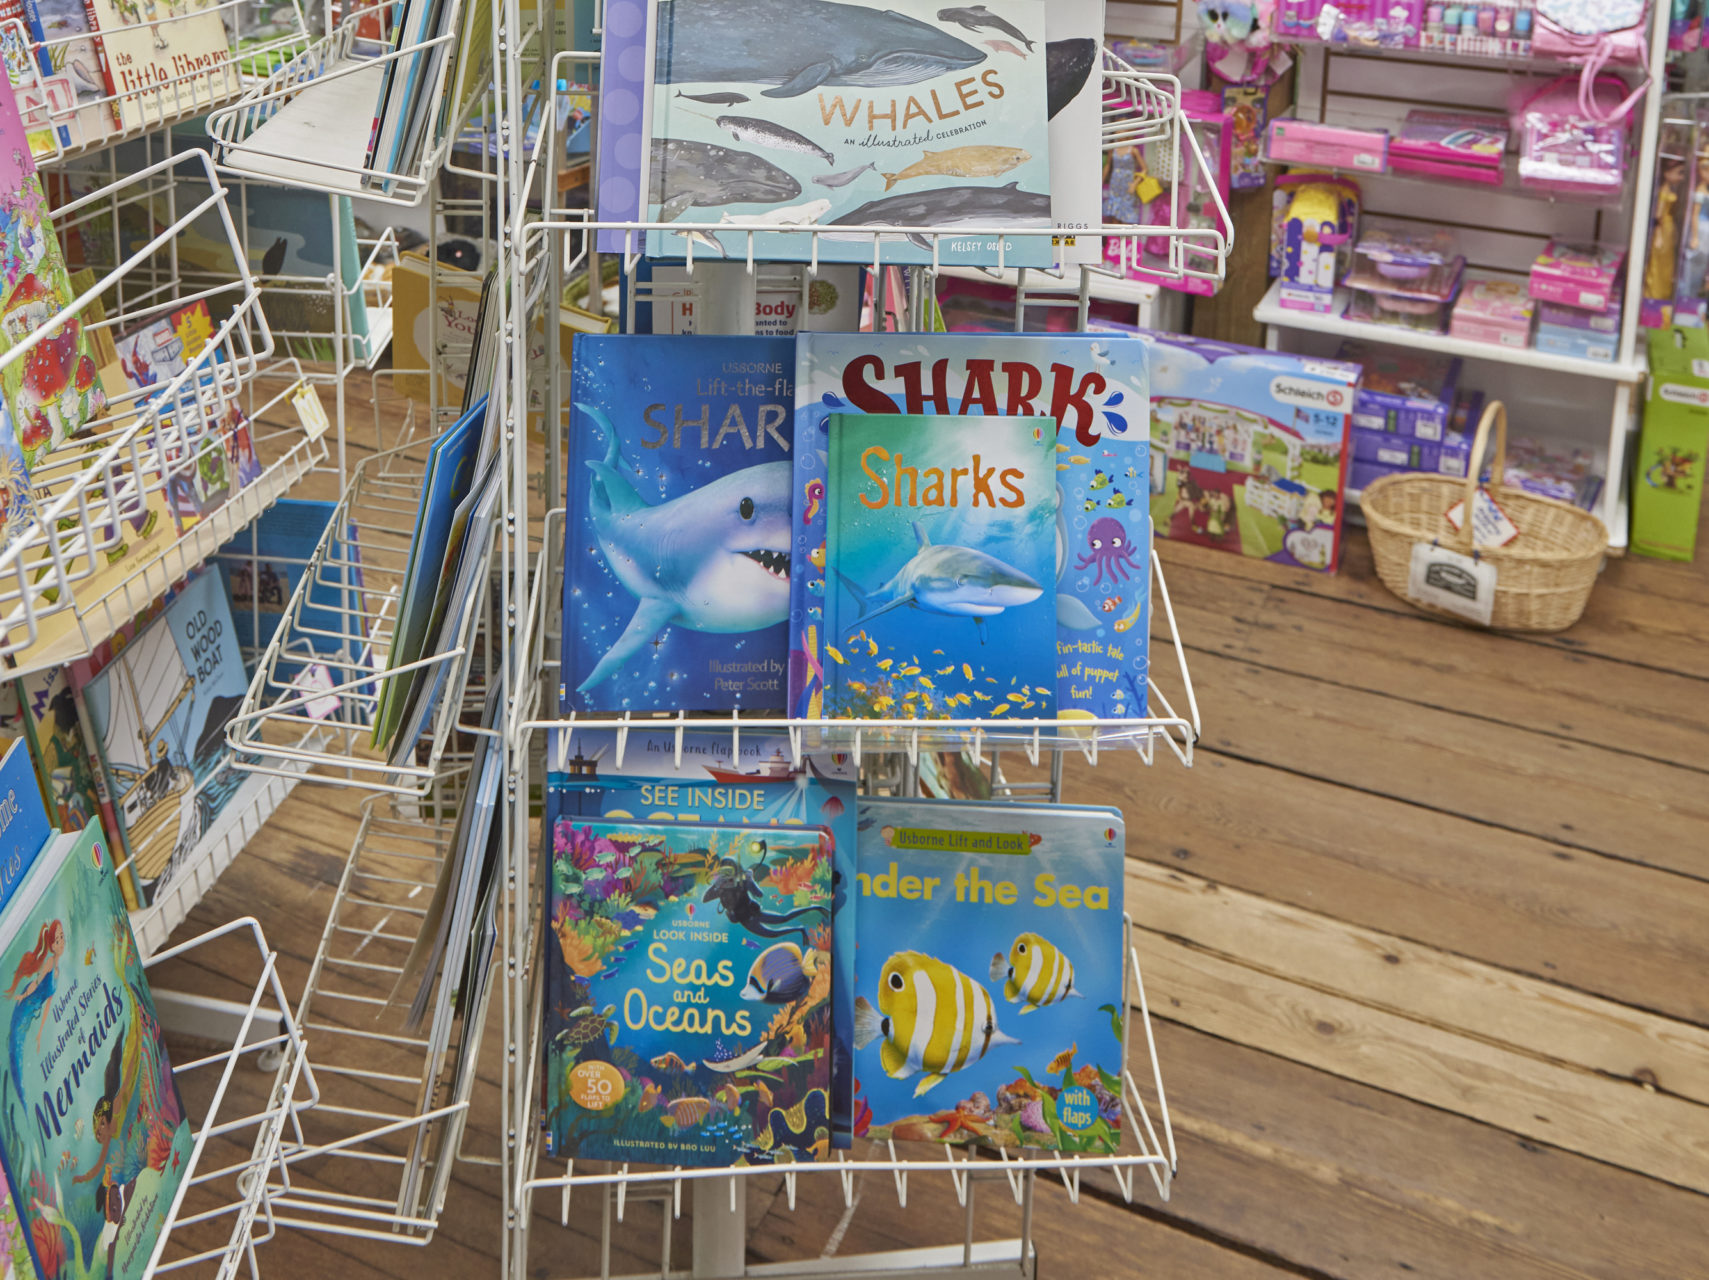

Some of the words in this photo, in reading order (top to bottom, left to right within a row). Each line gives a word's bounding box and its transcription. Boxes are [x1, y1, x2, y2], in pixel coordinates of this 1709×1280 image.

[116, 52, 132, 66] the
[120, 63, 169, 102] little
[172, 49, 229, 86] library
[818, 68, 1004, 131] WHALES
[858, 129, 934, 148] illustrated
[936, 119, 987, 140] CELEBRATION
[951, 241, 982, 252] KELSEY
[722, 362, 783, 374] USBORNE
[842, 355, 1106, 447] SHARK
[641, 403, 790, 452] SHAR
[858, 446, 1025, 509] Sharks
[186, 610, 207, 640] OLD
[191, 620, 222, 663] WOOD
[1107, 643, 1124, 661] tale
[197, 644, 223, 684] BOAT
[709, 659, 768, 673] Illustrated
[770, 659, 784, 677] by
[1071, 661, 1082, 676] of
[1084, 666, 1119, 684] puppet
[714, 677, 744, 691] Peter
[747, 677, 779, 691] Scott
[1071, 684, 1092, 700] fun!
[647, 739, 660, 752] An
[664, 741, 708, 755] Usorne
[641, 786, 679, 807] SEE
[688, 788, 765, 810] INSIDE
[899, 831, 945, 847] Usborne
[949, 833, 968, 848] Lift
[972, 835, 992, 850] and
[996, 836, 1023, 851] Look
[954, 866, 1018, 905] the
[1033, 873, 1109, 910] Sea
[672, 920, 710, 929] USBORNE
[653, 929, 686, 941] LOOK
[690, 931, 728, 943] INSIDE
[646, 942, 735, 987] Seas
[52, 978, 79, 1023] Usborne
[673, 986, 710, 1004] and
[623, 988, 751, 1037] Oceans
[40, 1008, 80, 1083] Illustrated
[78, 974, 101, 1017] Stories
[77, 1027, 86, 1045] of
[35, 981, 124, 1159] Mermaids
[577, 1070, 601, 1079] OVER
[587, 1079, 612, 1095] 50
[580, 1094, 601, 1102] FLAPS
[1064, 1089, 1090, 1106] with
[1063, 1107, 1091, 1128] flaps
[613, 1139, 665, 1149] ILLUSTRATED
[700, 1145, 716, 1153] LUU
